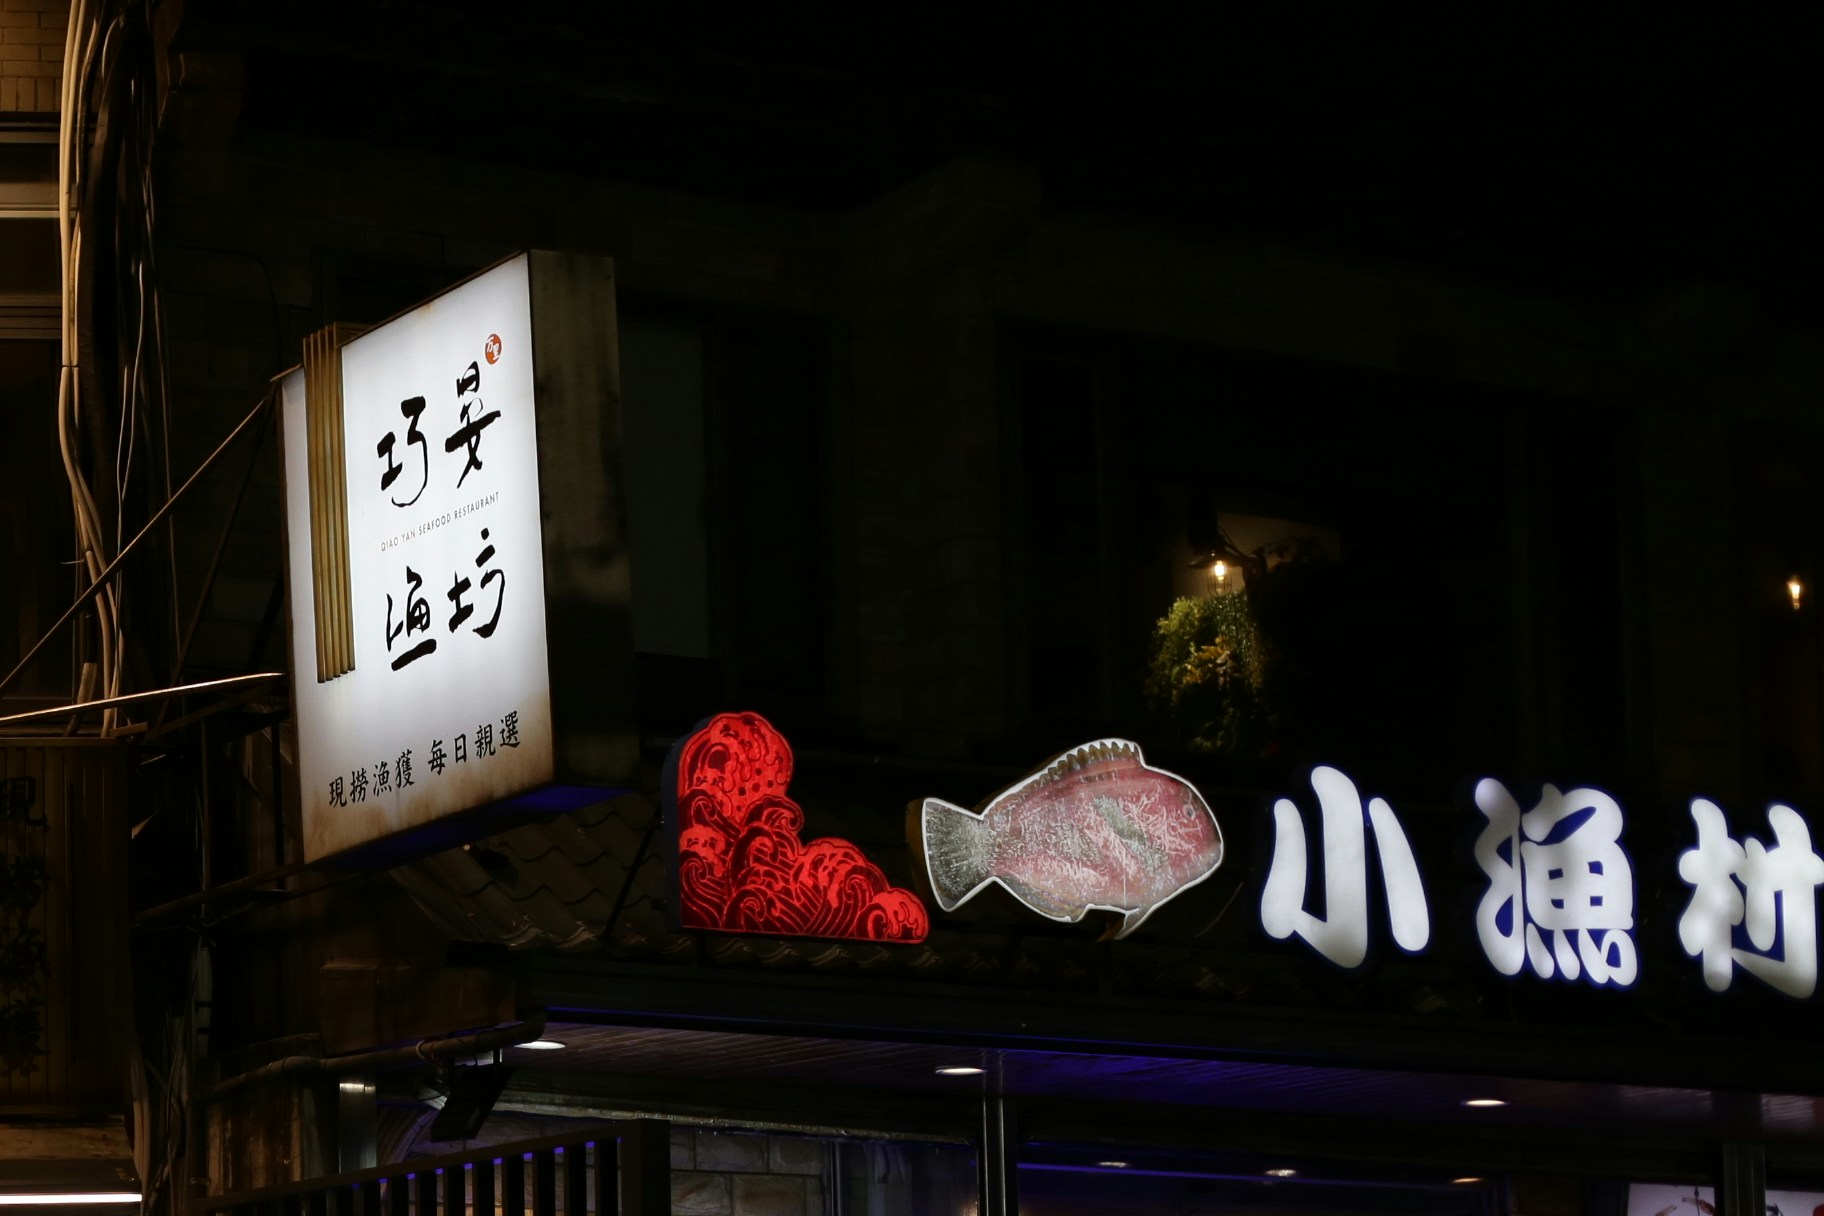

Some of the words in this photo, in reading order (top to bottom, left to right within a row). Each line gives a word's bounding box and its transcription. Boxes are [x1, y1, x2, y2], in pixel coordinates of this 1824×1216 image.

[484, 333, 502, 365] 万里
[380, 537, 399, 553] QIAO
[401, 528, 416, 544] YAN
[418, 513, 452, 536] SEAFOOD
[454, 491, 500, 521] RESTAURANT
[329, 748, 416, 809] 現撈漁獲
[427, 710, 521, 776] 每日親選
[1261, 765, 1824, 1000] 小漁村
